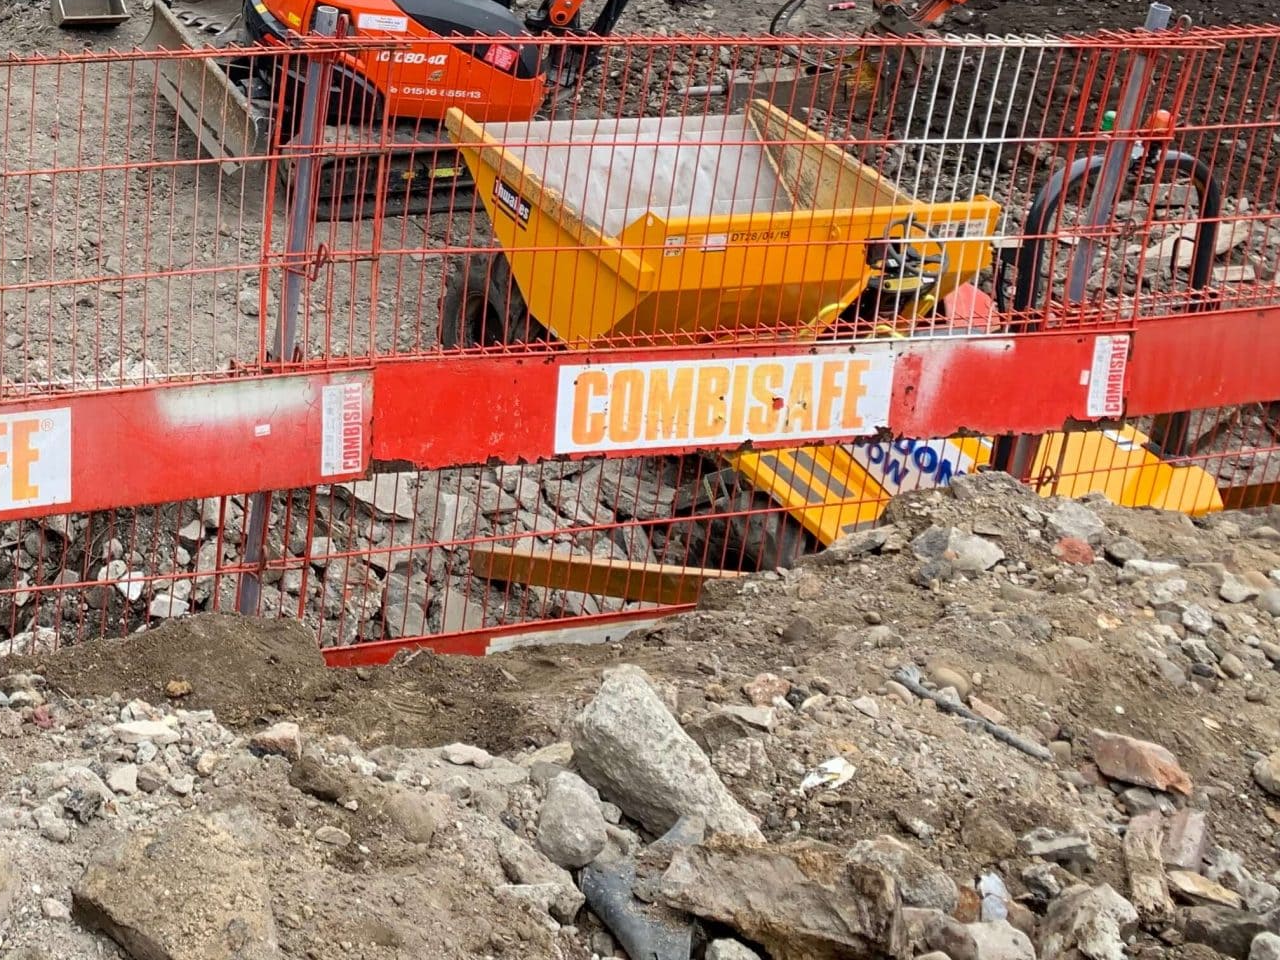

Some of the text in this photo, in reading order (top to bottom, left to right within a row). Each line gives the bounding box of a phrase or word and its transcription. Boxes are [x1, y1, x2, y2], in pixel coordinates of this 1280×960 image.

[572, 359, 871, 445] COMBISAFE
[1105, 337, 1128, 412] COMBISAFE
[342, 386, 361, 471] COMBISAFE
